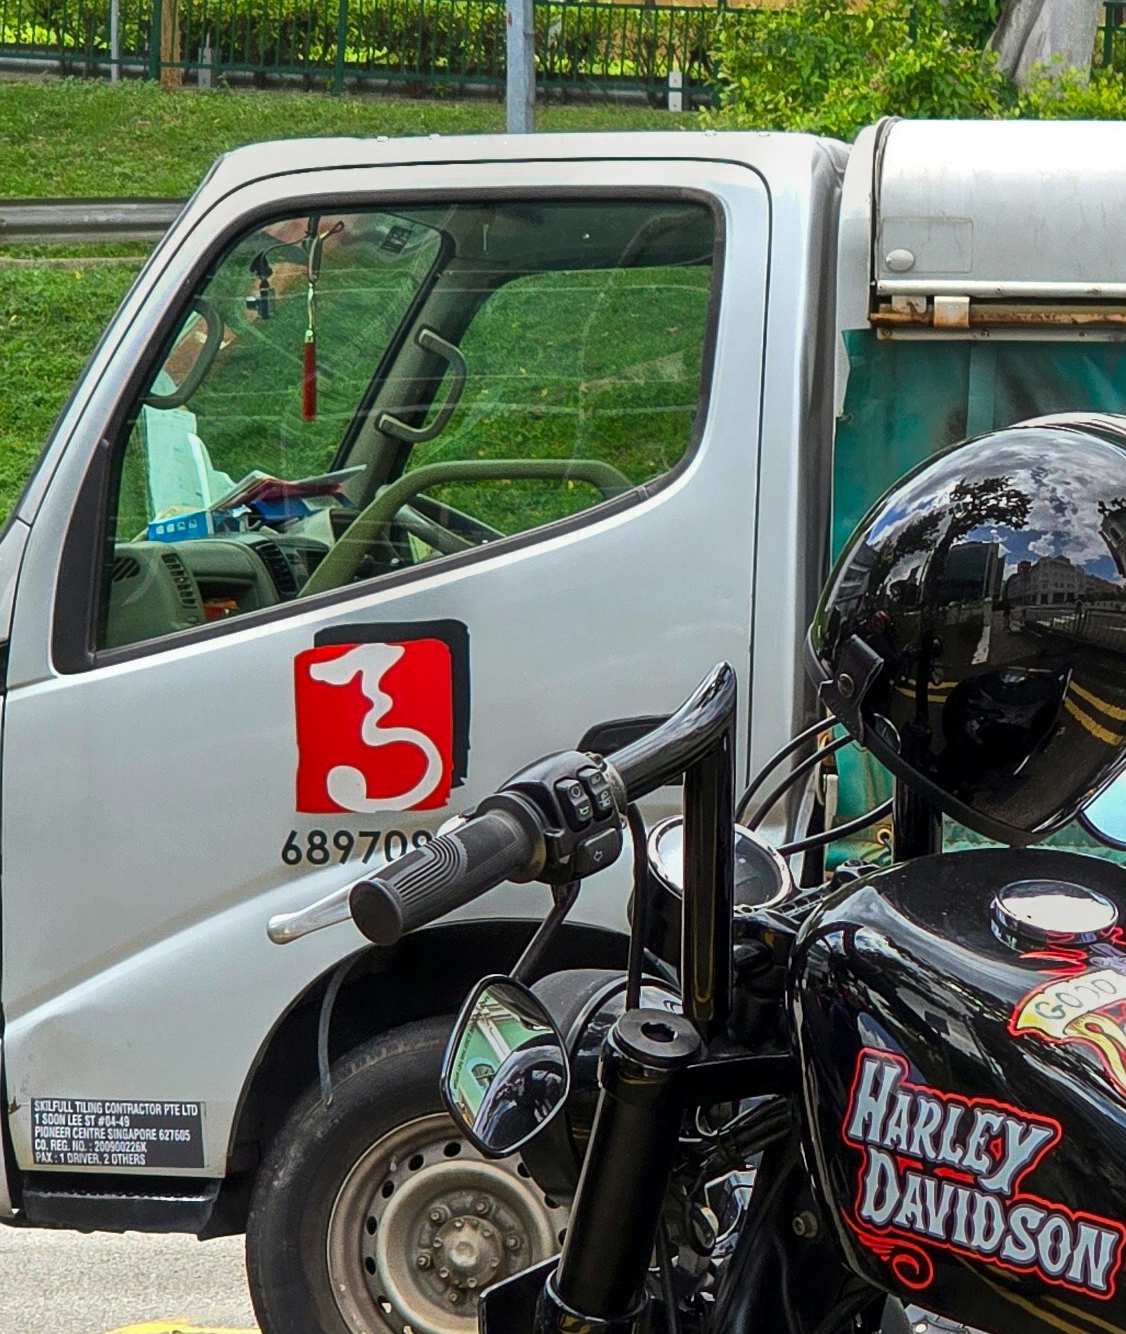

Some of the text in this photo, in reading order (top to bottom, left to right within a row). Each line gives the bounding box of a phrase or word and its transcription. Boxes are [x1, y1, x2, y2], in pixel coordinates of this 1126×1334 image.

[34, 1100, 198, 1116] SKILFULL TILING CONTRACTOR PTE LTD
[34, 1113, 39, 1125] 1
[42, 1113, 66, 1125] SOON
[67, 1114, 83, 1126] LEE
[84, 1115, 96, 1126] ST
[34, 1126, 71, 1139] PIONEER
[72, 1127, 106, 1139] CENTRE
[107, 1128, 157, 1140] SINGAPORE
[847, 1058, 1055, 1197] HARLEY
[34, 1139, 49, 1151] CO.
[50, 1139, 71, 1151] REG.
[59, 1153, 65, 1164] 1
[103, 1153, 110, 1165] 2
[111, 1154, 146, 1166] OTHERS
[860, 1145, 1123, 1292] DAVIDSON
